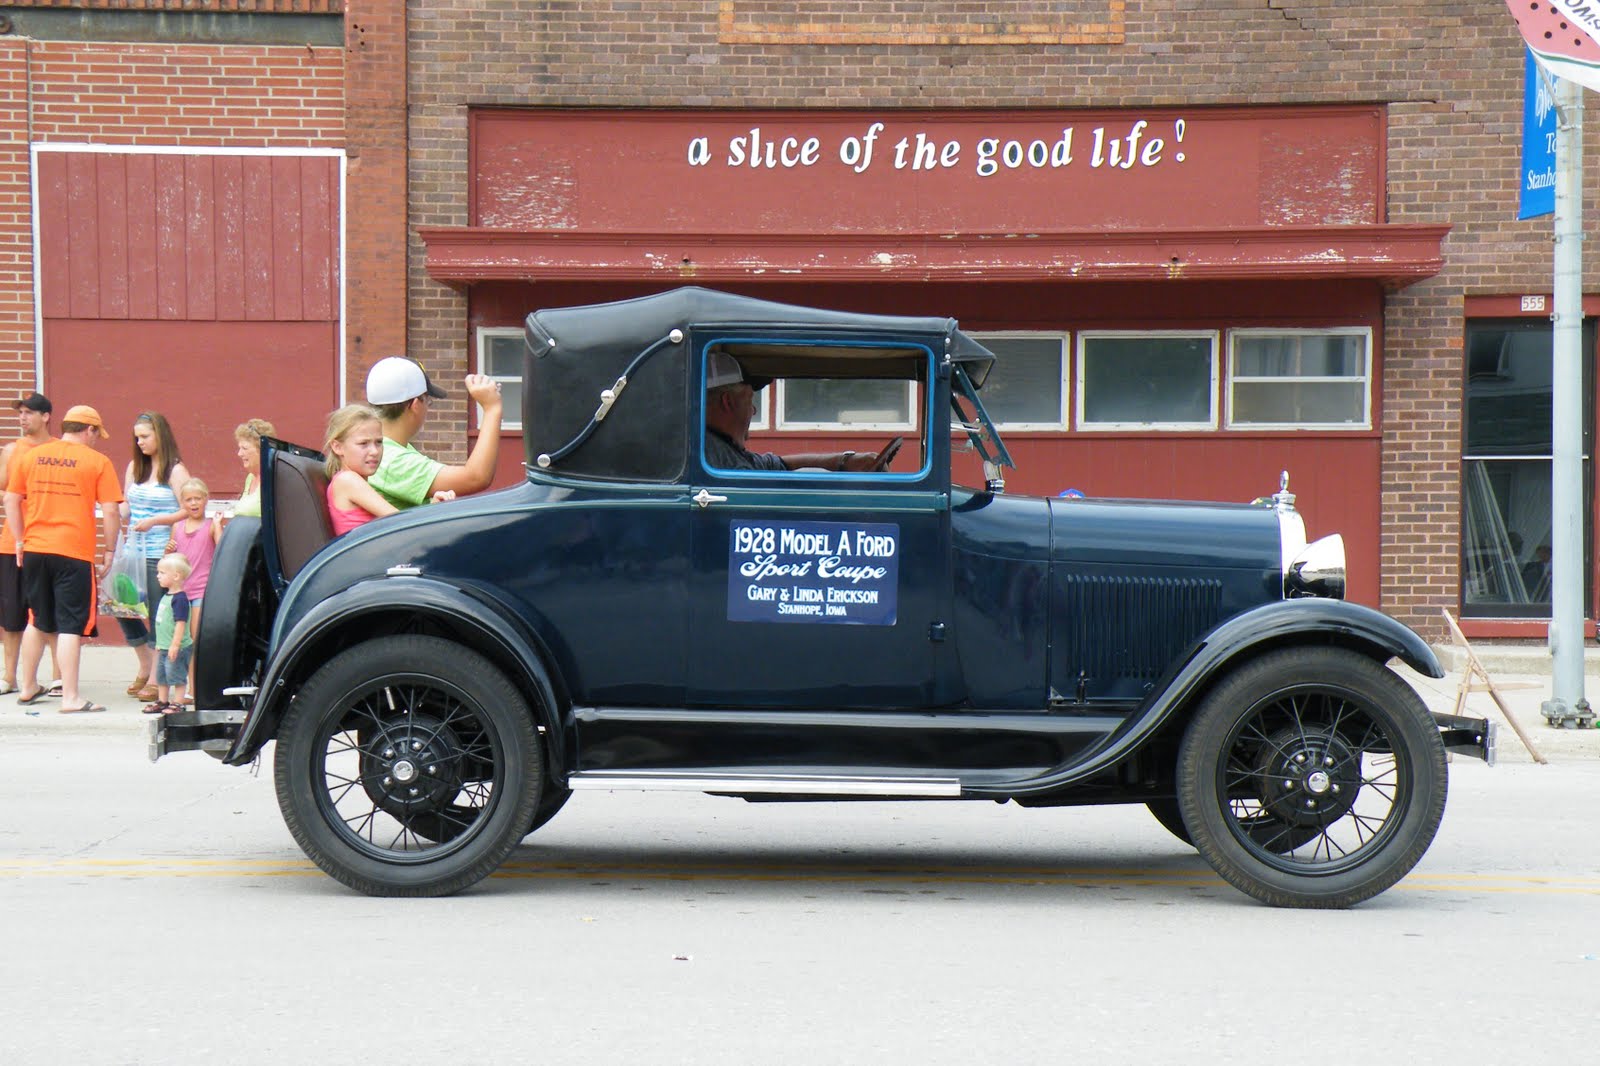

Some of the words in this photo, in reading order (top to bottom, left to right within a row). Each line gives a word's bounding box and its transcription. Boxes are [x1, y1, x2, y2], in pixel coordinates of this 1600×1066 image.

[687, 136, 712, 166] a
[727, 127, 820, 169] slice
[839, 122, 885, 173] of
[894, 133, 961, 170] the
[976, 127, 1073, 177] good
[1522, 297, 1544, 310] 555
[734, 526, 776, 554] 1928
[780, 528, 833, 556] MODEL
[836, 530, 852, 556] A
[856, 530, 895, 557] FORD
[740, 554, 812, 581] Sport
[817, 556, 887, 584] Coupe
[747, 584, 778, 601] GARY
[780, 588, 790, 602] &
[793, 586, 825, 602] LINDA
[827, 587, 879, 604] ERICKSON
[825, 603, 847, 616] IOWA
